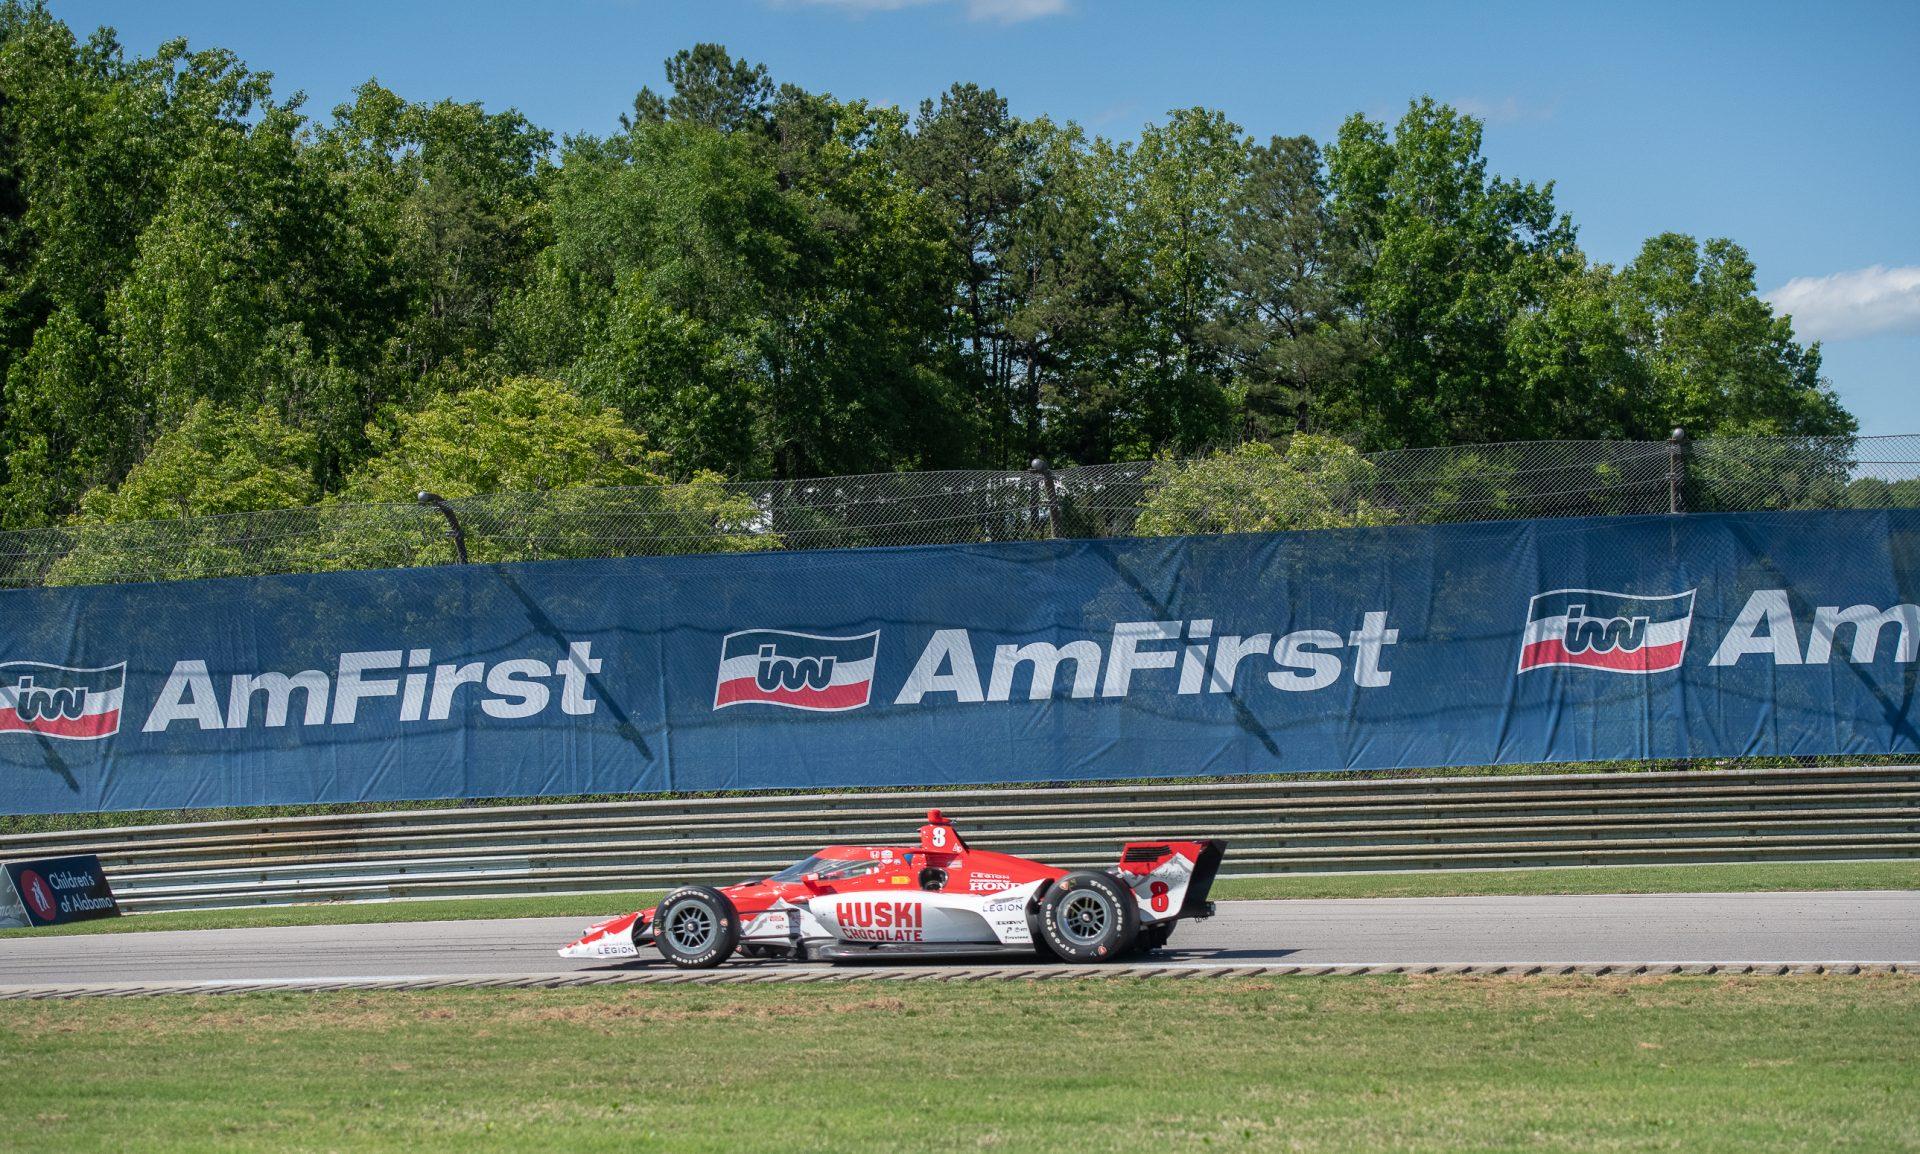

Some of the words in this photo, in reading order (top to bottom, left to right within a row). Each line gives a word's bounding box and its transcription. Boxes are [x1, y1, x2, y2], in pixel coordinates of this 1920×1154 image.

[894, 611, 1399, 704] AmFirst
[142, 641, 603, 733] AmFirst
[932, 827, 946, 848] 8
[48, 871, 95, 890] Children's
[61, 895, 71, 913] of
[72, 893, 113, 912] Alabama
[1150, 881, 1169, 912] 8
[836, 902, 922, 928] HUSKI
[983, 904, 1023, 912] LEGION
[842, 928, 922, 941] CHOCOLATE
[598, 946, 634, 954] LEGION
